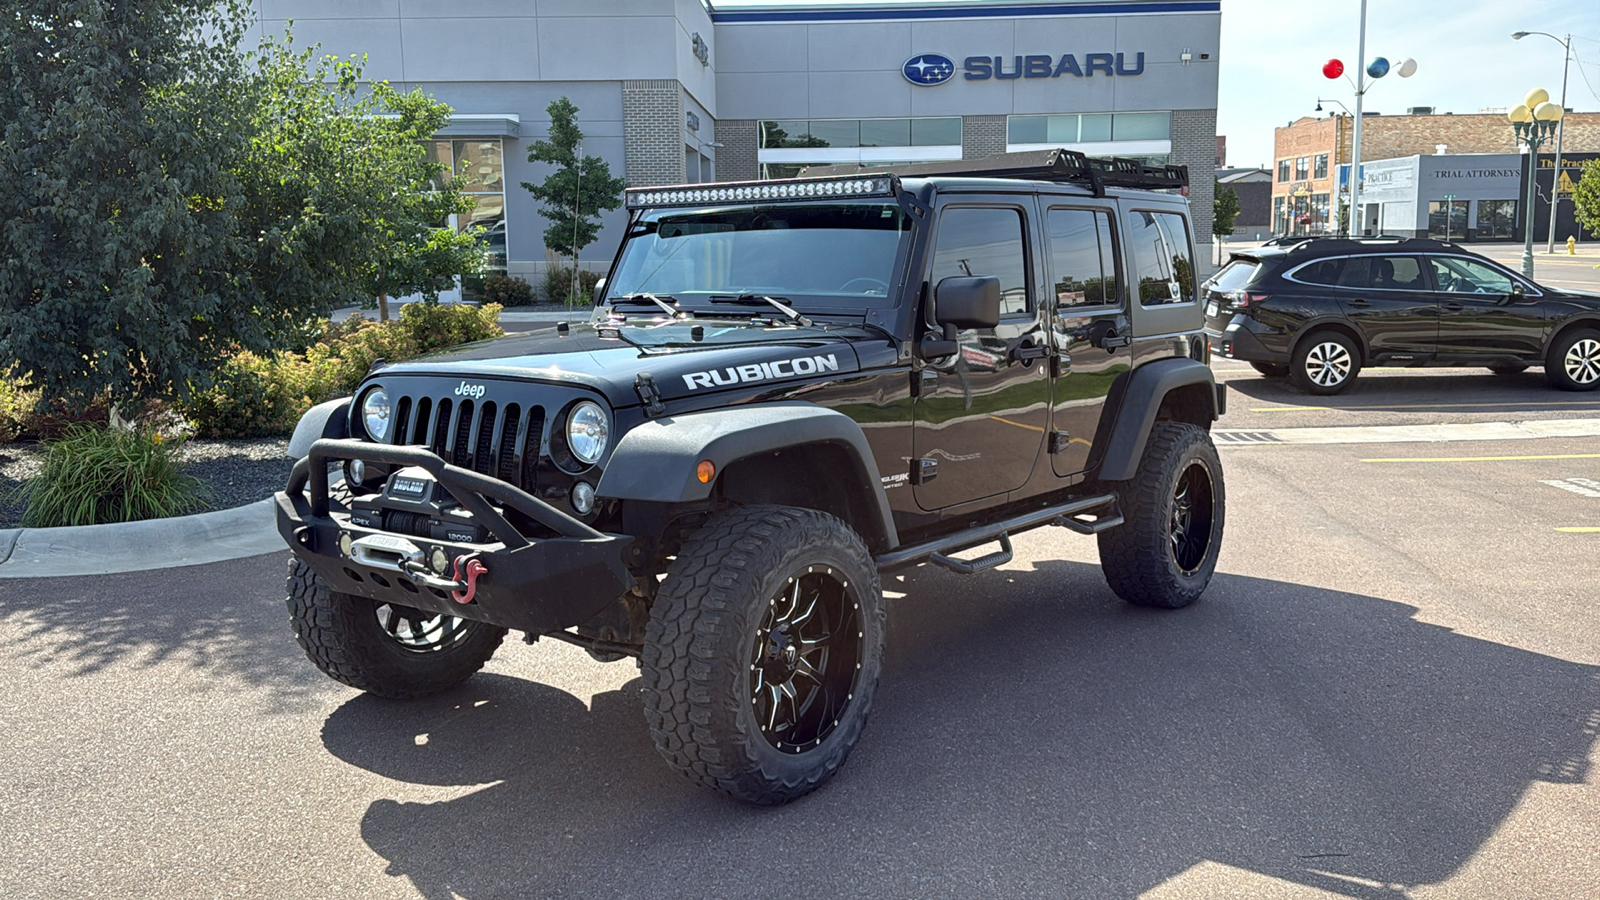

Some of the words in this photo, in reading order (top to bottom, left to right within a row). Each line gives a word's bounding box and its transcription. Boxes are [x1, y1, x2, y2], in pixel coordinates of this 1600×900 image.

[964, 52, 1145, 80] SUBARU
[1561, 159, 1587, 168] Pract
[1368, 172, 1393, 183] PRACTICE
[1435, 170, 1464, 178] TRIAL
[1466, 169, 1521, 178] ATTORNEYS
[682, 353, 840, 391] RUBICON
[454, 380, 486, 399] Jeep
[393, 479, 424, 493] BADLAND
[351, 517, 370, 526] APEX
[448, 532, 473, 543] 12000
